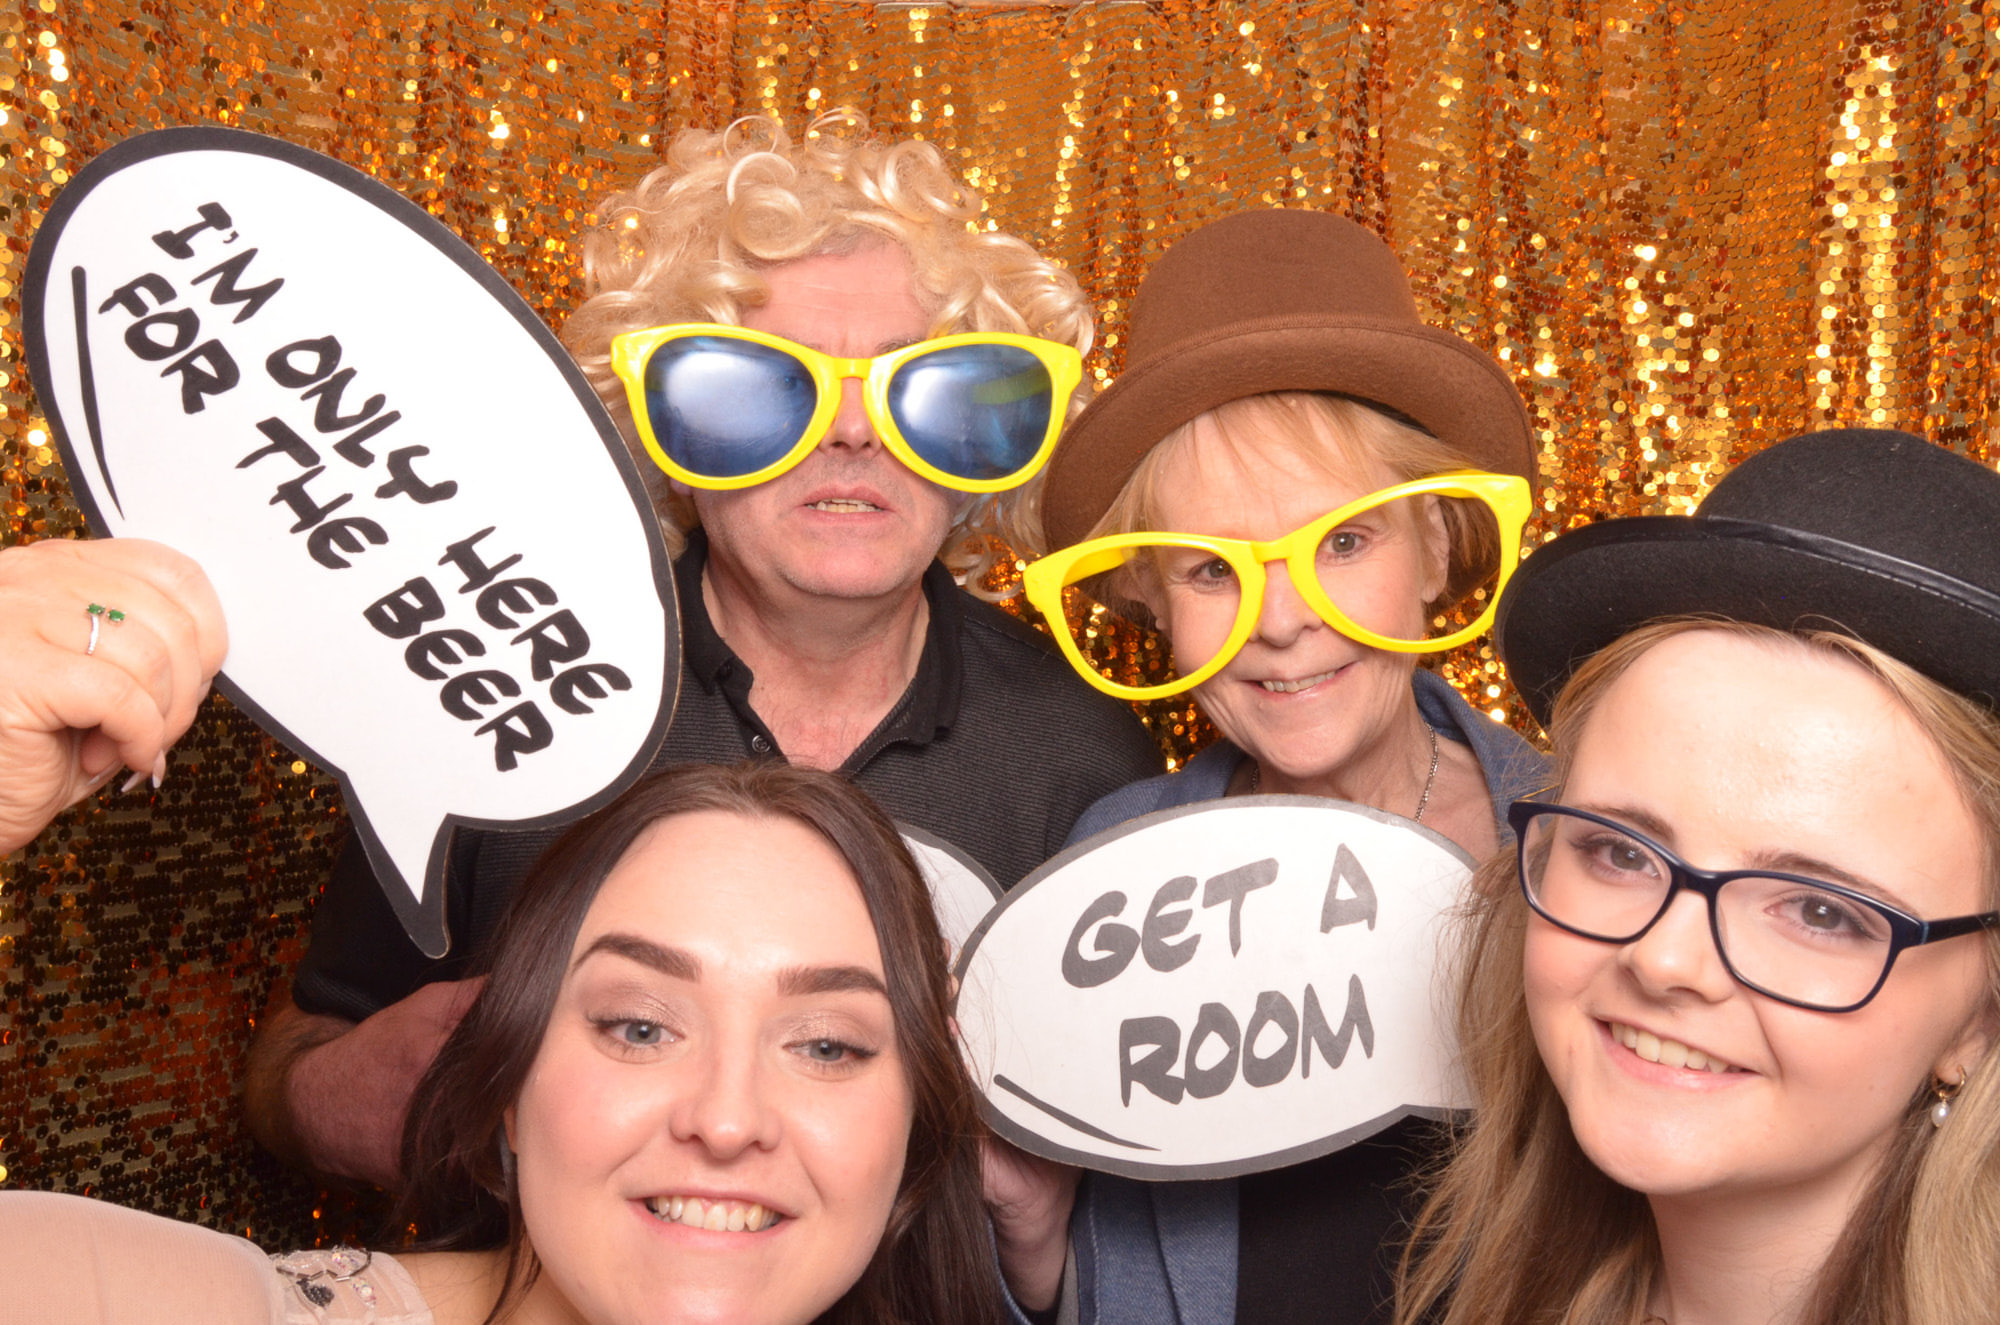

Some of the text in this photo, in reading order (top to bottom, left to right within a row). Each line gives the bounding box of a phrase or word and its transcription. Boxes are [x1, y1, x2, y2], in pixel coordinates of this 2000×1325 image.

[98, 273, 554, 772] FOR THE BEER
[152, 202, 632, 715] I'M ONLY HERE
[1062, 842, 1378, 988] GET A
[1119, 974, 1375, 1107] ROOM
